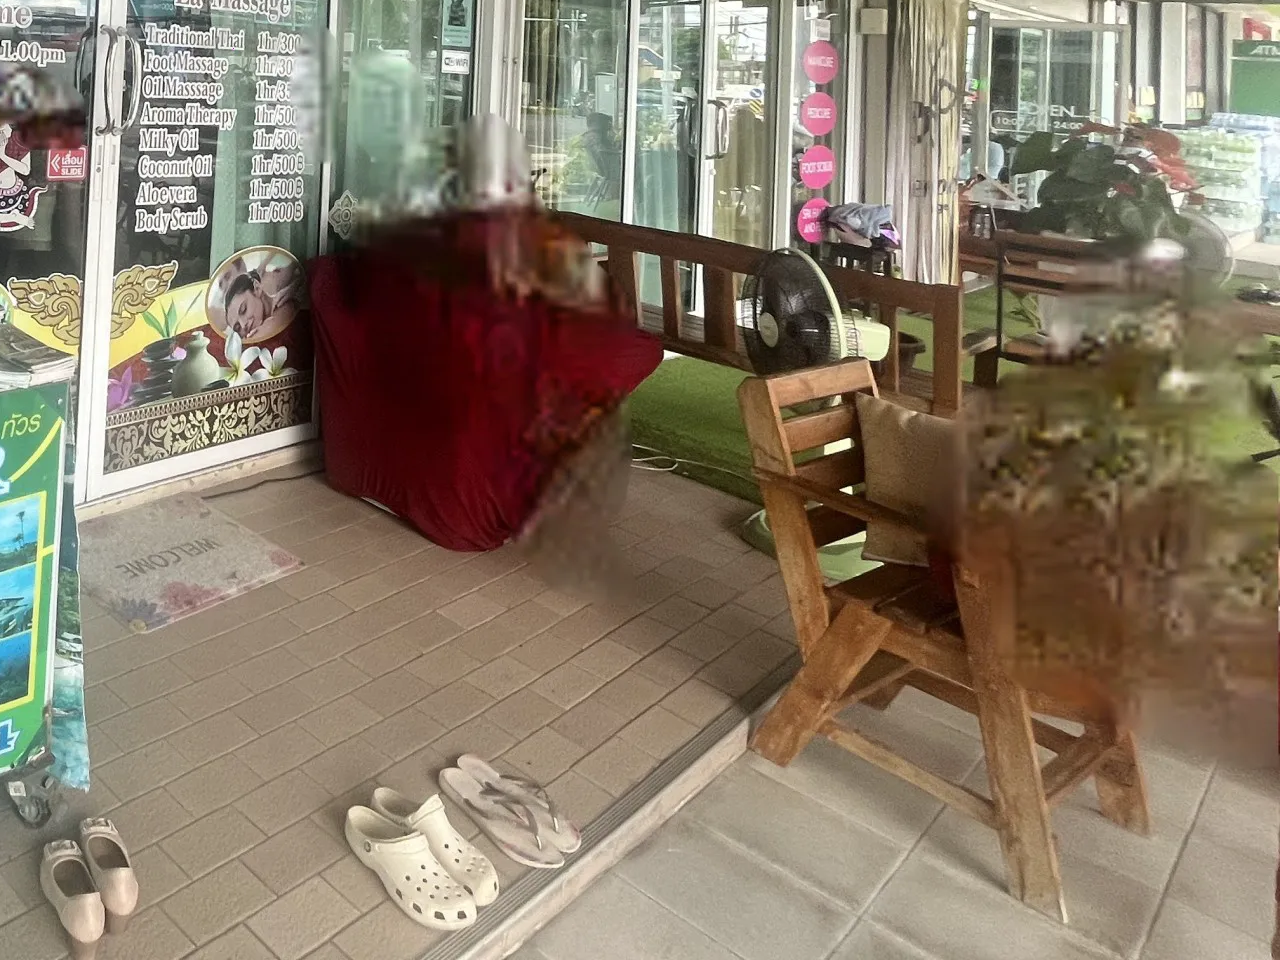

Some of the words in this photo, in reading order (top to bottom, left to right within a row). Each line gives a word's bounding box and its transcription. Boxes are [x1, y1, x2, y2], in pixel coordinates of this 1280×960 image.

[145, 22, 216, 48] Traditional
[217, 27, 245, 50] Thai
[257, 30, 302, 54] 1hr/300
[143, 49, 175, 72] Foot
[175, 50, 229, 80] Massage
[255, 54, 293, 76] 1hr/30
[142, 75, 163, 98] Oil
[164, 76, 224, 105] Masssage
[141, 101, 186, 125] Aroma
[185, 102, 237, 131] Therapy
[139, 128, 178, 157] Milky
[179, 128, 199, 151] Oil
[61, 167, 83, 176] SLIDE
[138, 155, 192, 178] Coconut
[193, 154, 213, 177] Oil
[135, 208, 171, 234] Body
[170, 205, 208, 231] Scrub
[116, 537, 222, 580] WELCOME
